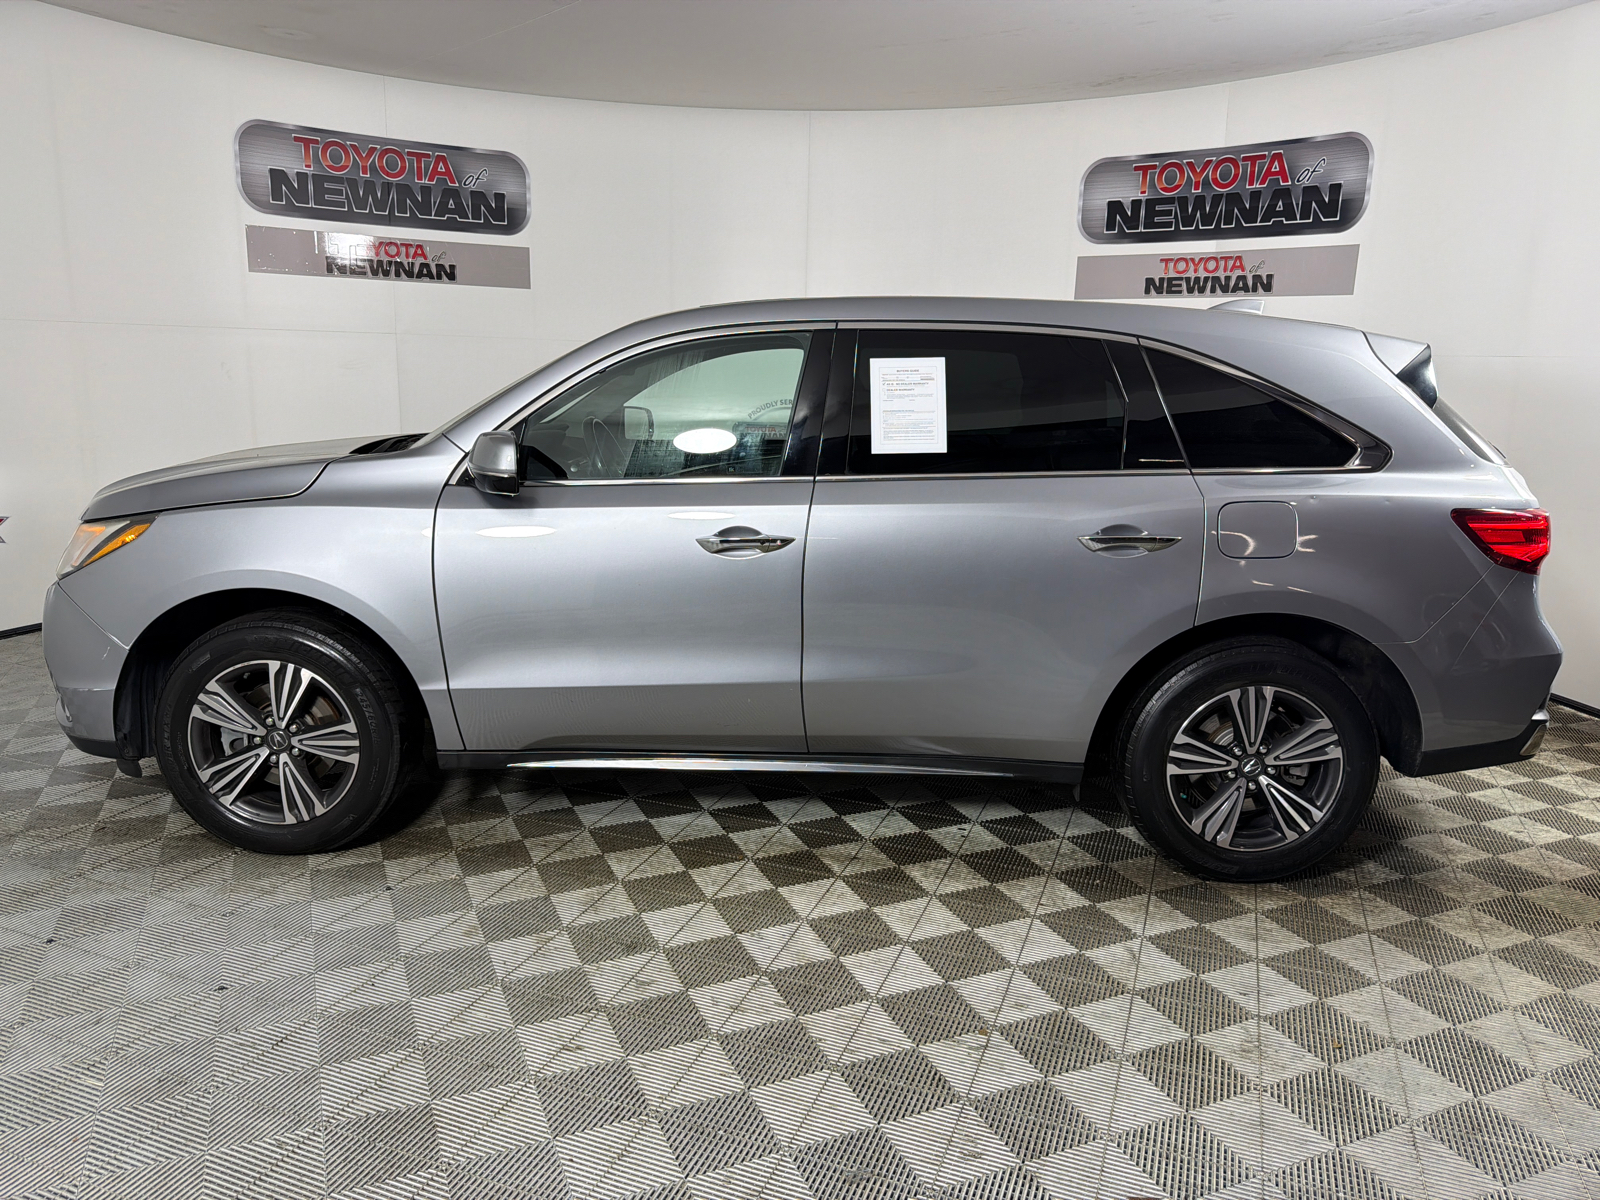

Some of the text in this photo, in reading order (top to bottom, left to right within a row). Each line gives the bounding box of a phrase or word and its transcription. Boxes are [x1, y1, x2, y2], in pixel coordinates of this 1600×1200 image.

[292, 134, 488, 188] TOYOTA of
[1133, 150, 1326, 196] TOYOTA of
[268, 166, 508, 225] NEWNAN
[1104, 181, 1343, 234] NEWNAN
[353, 238, 446, 263] YOTA of
[325, 256, 457, 282] NEWNAN
[1159, 255, 1265, 275] TOYOTA of
[1144, 274, 1274, 295] NEWNAN
[748, 400, 779, 419] PROUDLY
